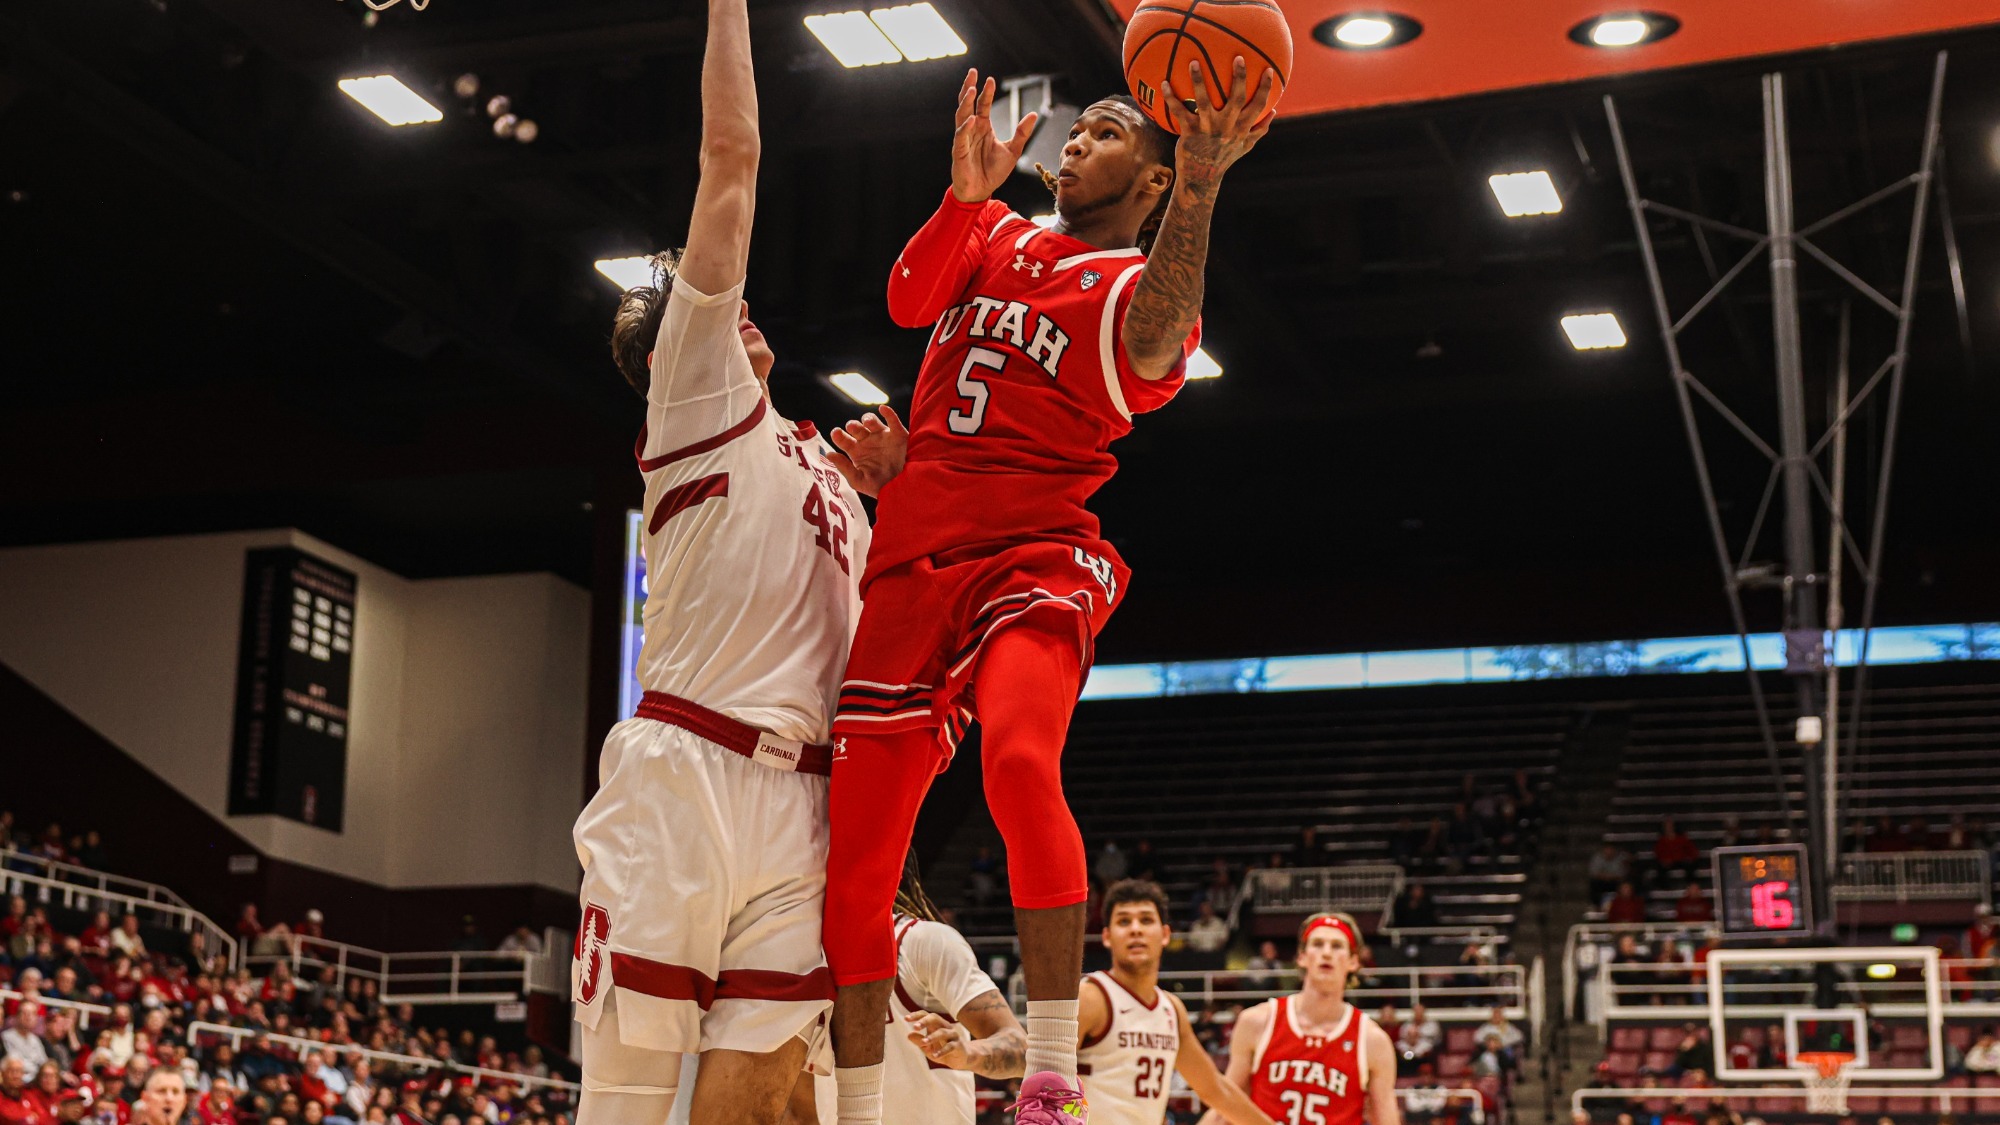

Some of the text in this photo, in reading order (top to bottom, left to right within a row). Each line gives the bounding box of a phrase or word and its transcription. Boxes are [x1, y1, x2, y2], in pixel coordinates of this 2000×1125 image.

[938, 296, 1070, 379] UTAH
[948, 345, 1008, 435] 5
[802, 481, 850, 577] 42
[760, 743, 796, 762] CARDINAL
[1751, 881, 1794, 929] 16
[1118, 1031, 1176, 1051] STANFOR
[1135, 1056, 1165, 1099] 23
[1268, 1059, 1348, 1098] UTAH
[1277, 1089, 1330, 1125] 35
